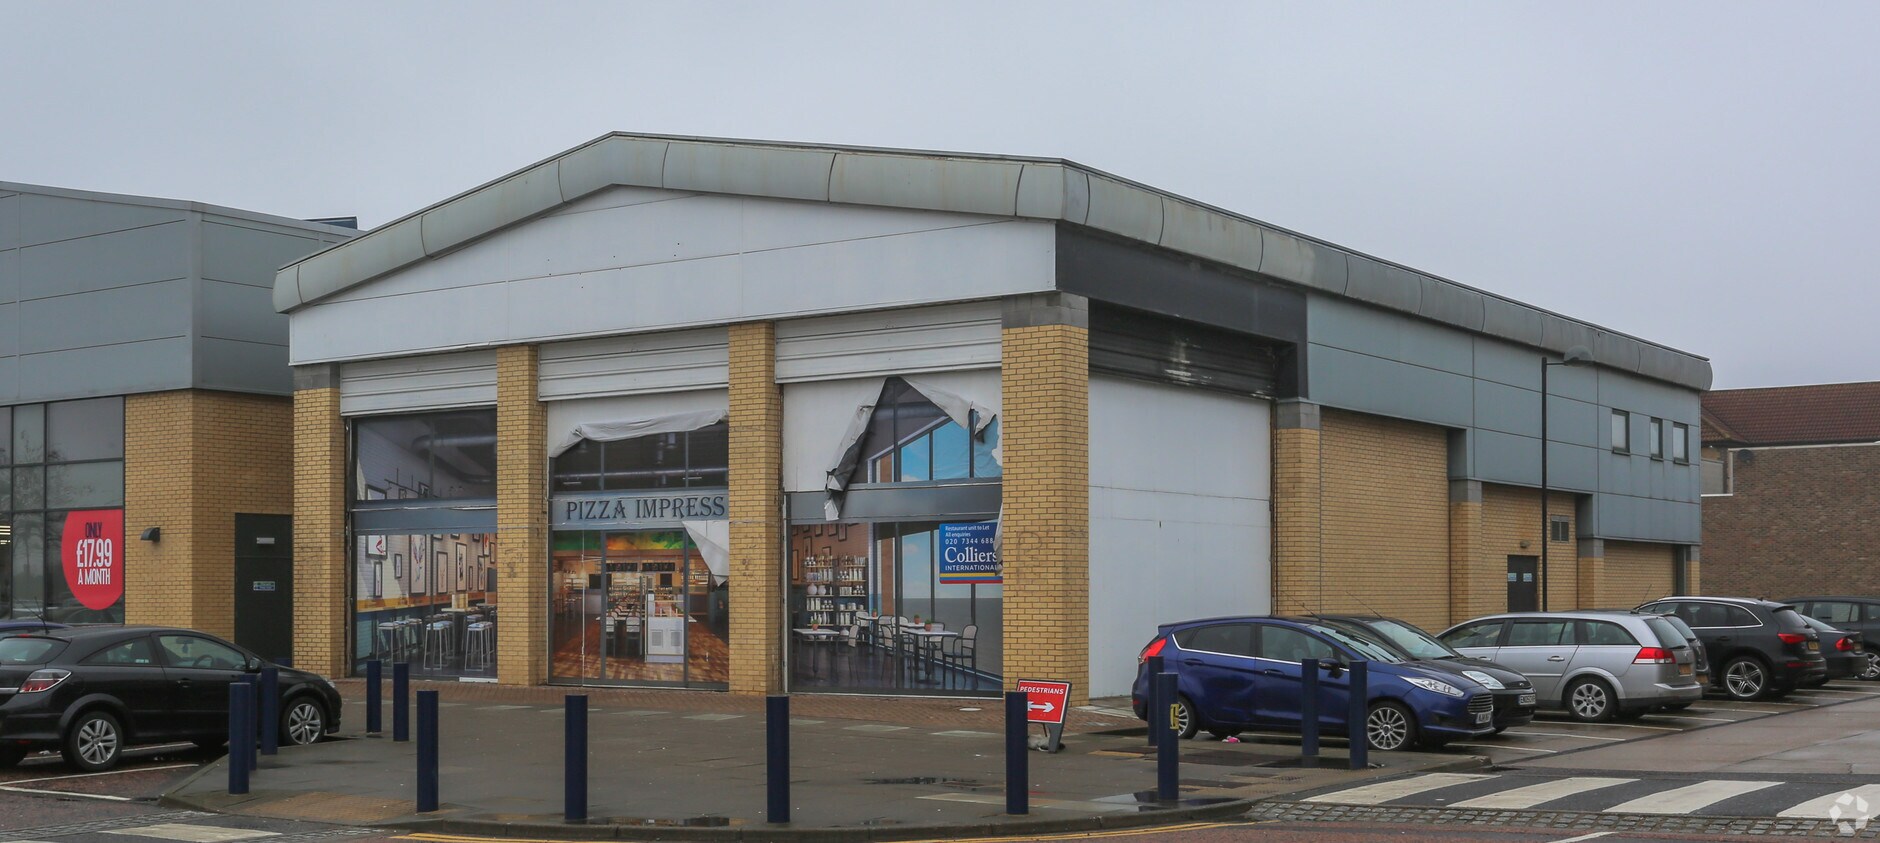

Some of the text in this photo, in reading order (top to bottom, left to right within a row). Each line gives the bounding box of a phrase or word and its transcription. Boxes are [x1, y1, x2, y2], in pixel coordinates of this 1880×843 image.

[566, 496, 725, 520] PIZZA IMPRESS
[85, 522, 103, 538] ONLY
[76, 538, 113, 567] £17.99
[944, 546, 997, 563] Colliers
[77, 568, 111, 585] A MONTH
[1020, 686, 1064, 694] PEDESTRIANS
